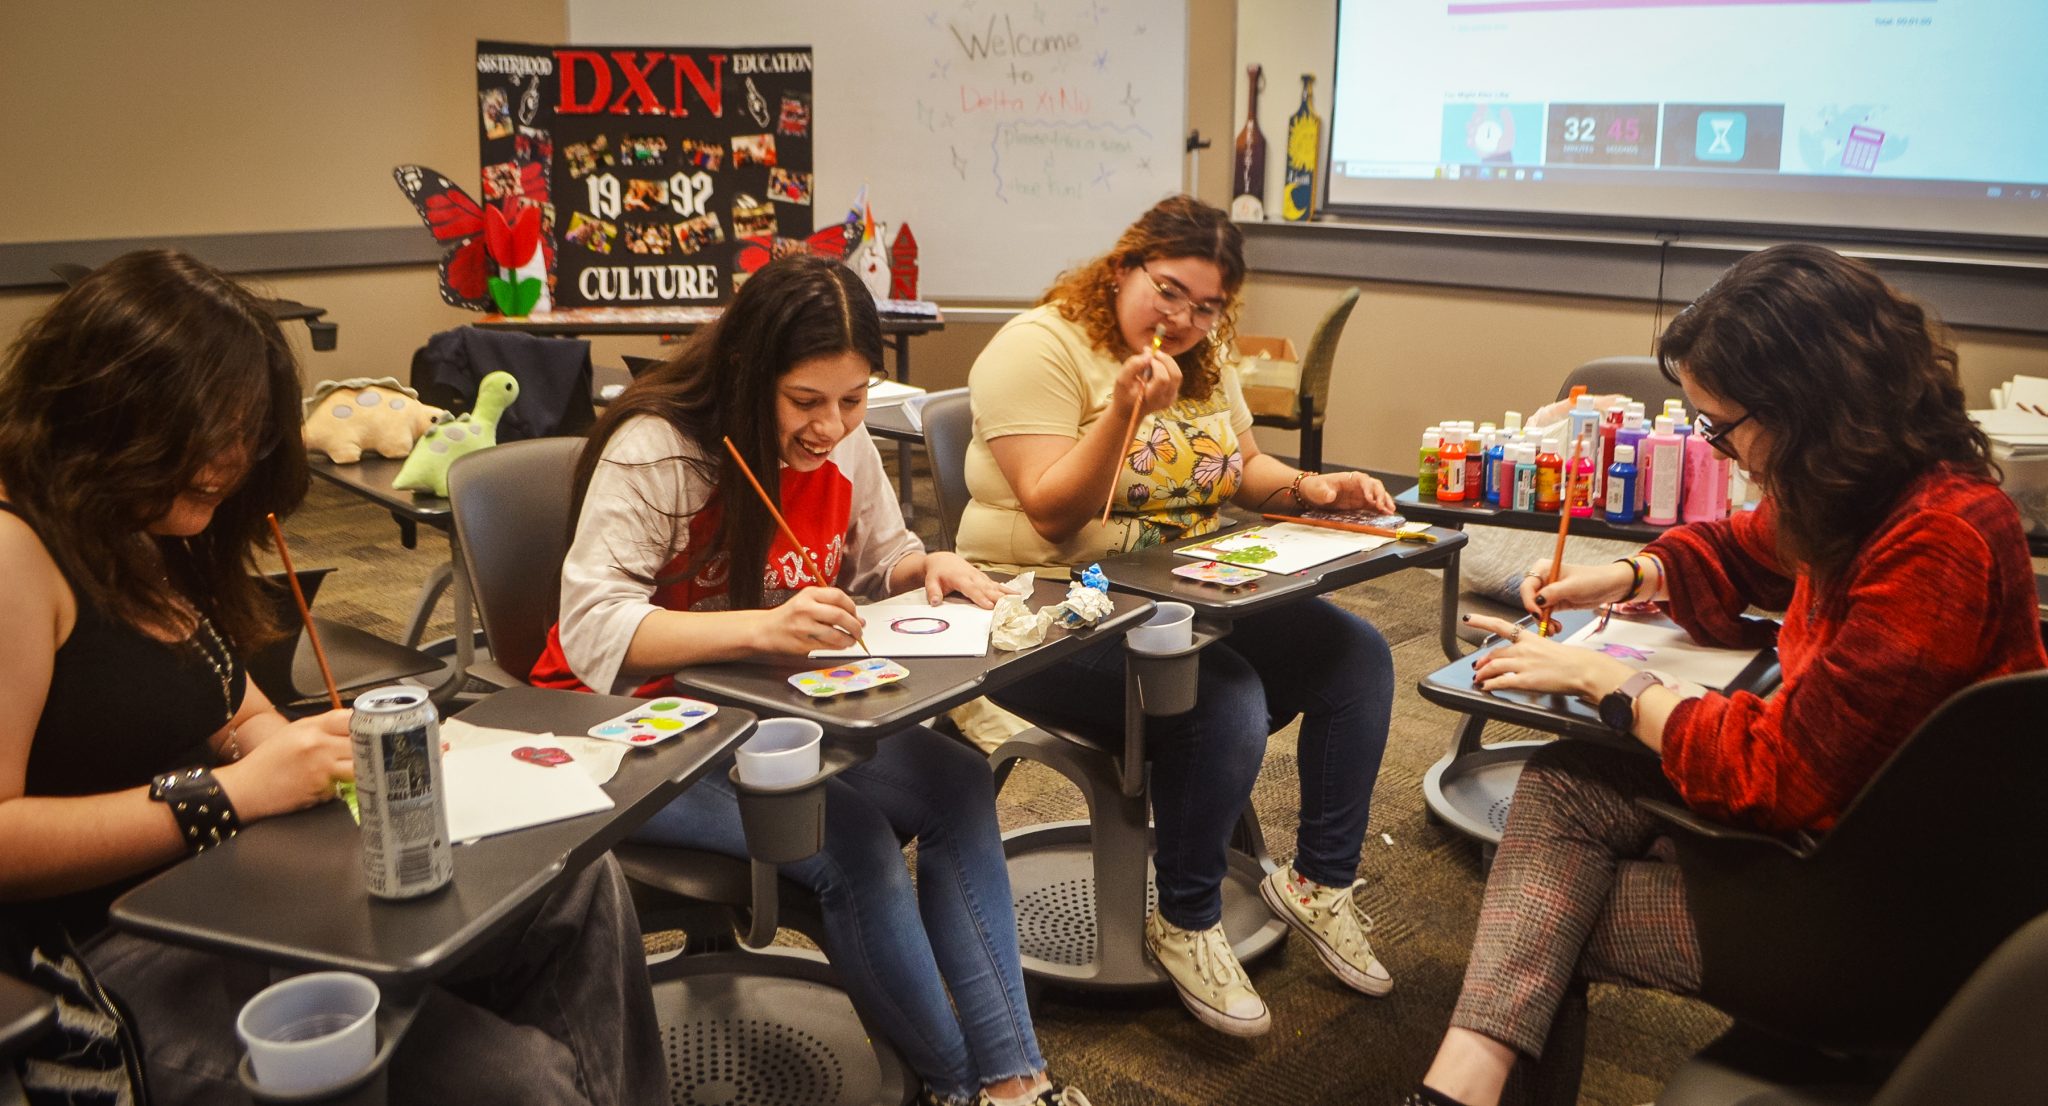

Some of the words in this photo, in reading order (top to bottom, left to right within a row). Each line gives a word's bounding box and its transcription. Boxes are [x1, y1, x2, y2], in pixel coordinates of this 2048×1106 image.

[951, 14, 1079, 60] Welcome
[477, 54, 553, 77] SISTERHOOD
[733, 52, 812, 74] EDUCATION
[1006, 62, 1033, 85] to
[552, 51, 727, 117] DXN
[1564, 117, 1596, 142] 32
[1607, 118, 1640, 142] 45
[586, 172, 622, 220] 19
[579, 265, 718, 300] CULTURE
